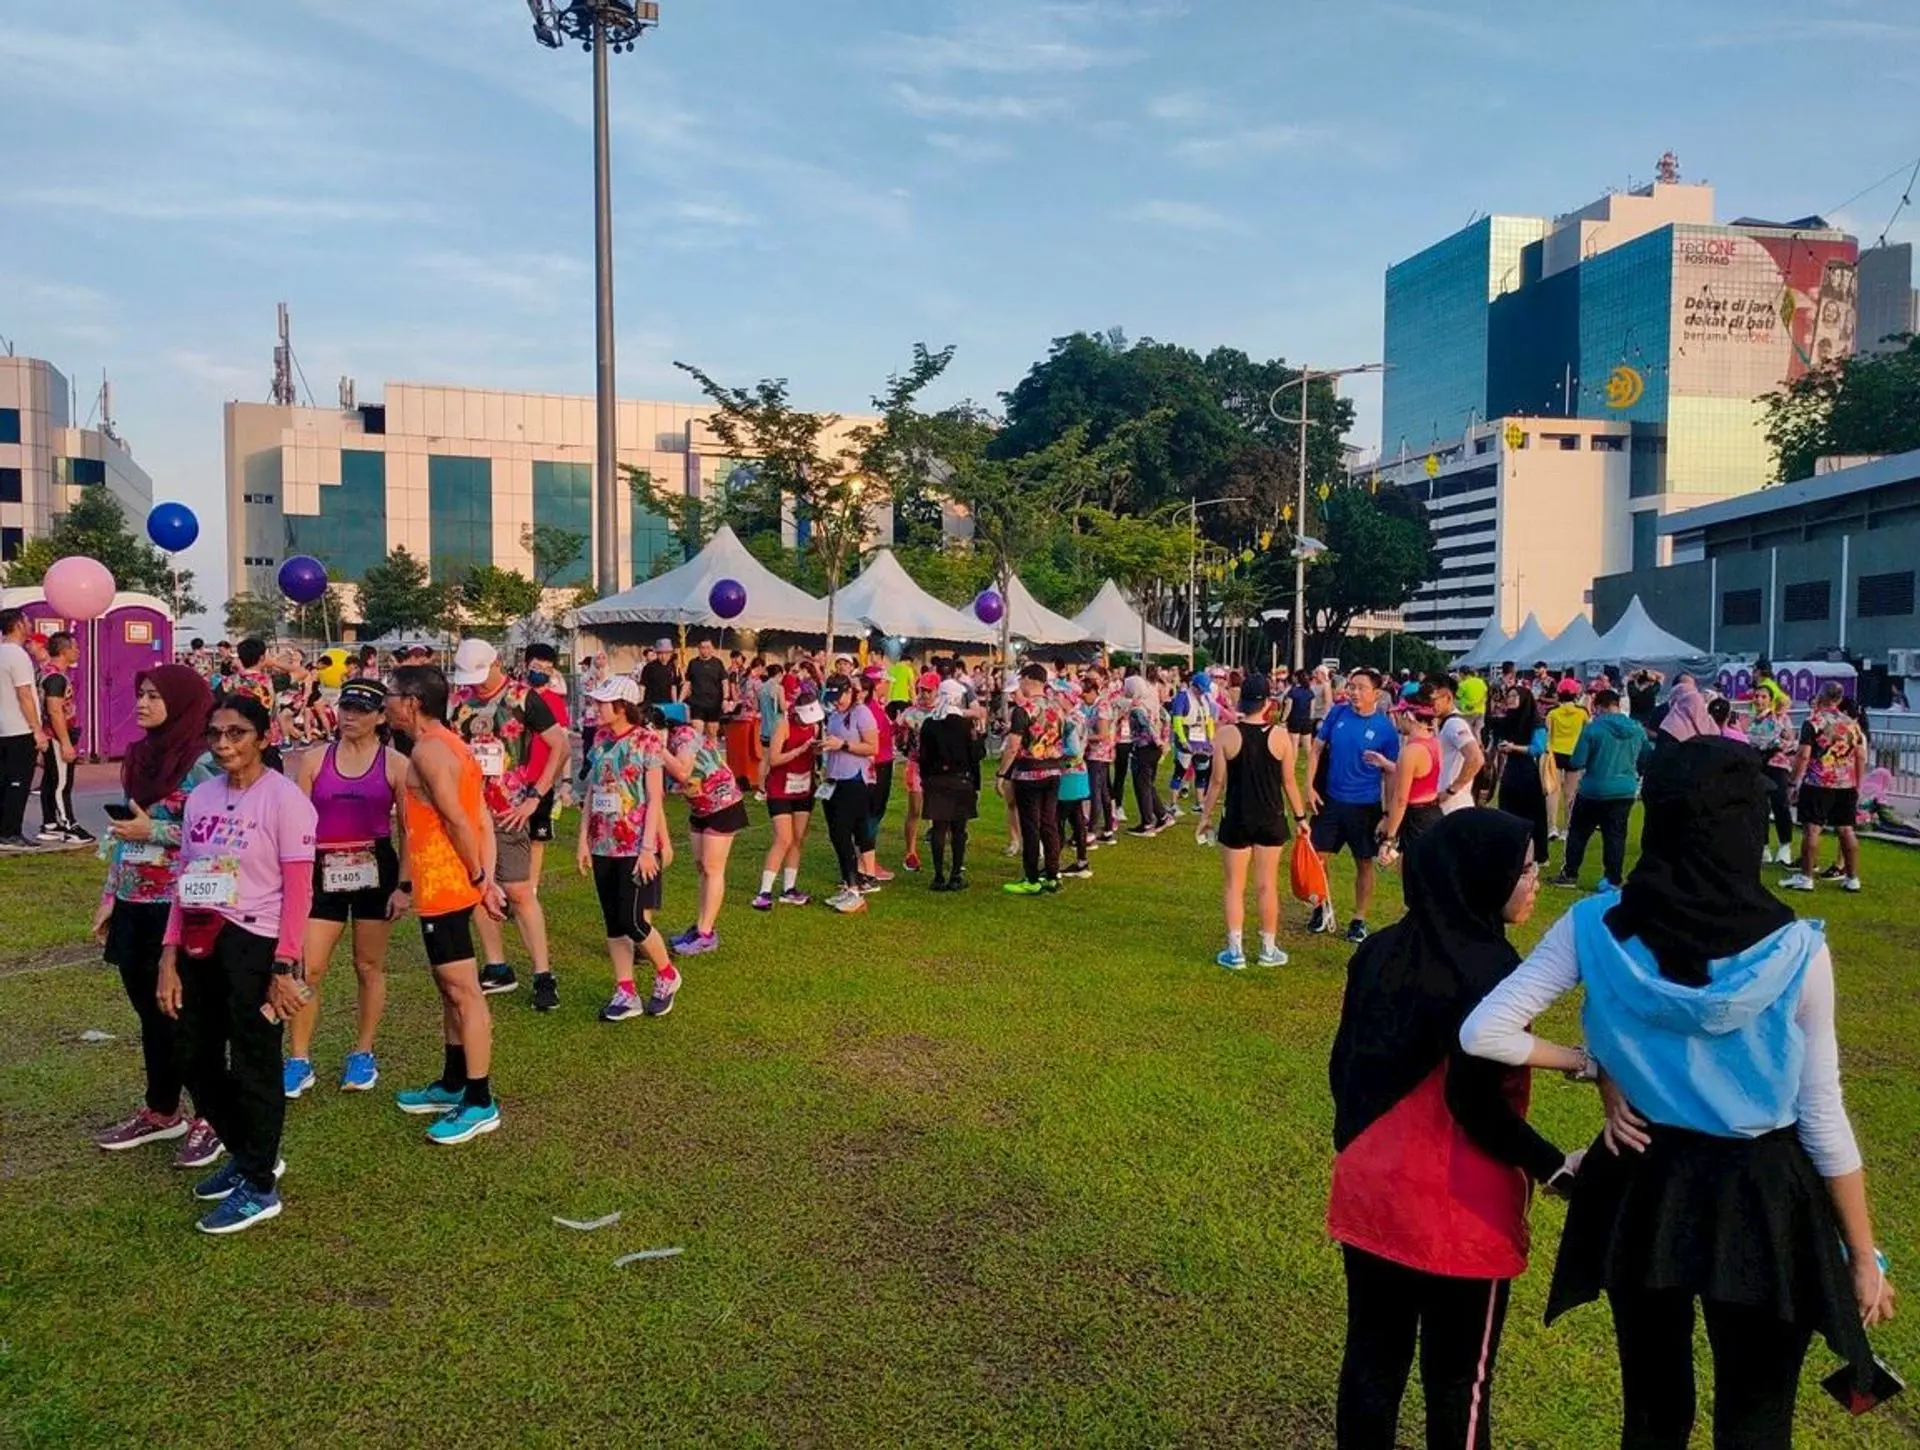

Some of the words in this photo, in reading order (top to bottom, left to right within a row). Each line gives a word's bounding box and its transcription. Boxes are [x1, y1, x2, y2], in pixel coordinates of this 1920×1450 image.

[1680, 239, 1736, 255] redONE
[1684, 254, 1730, 266] POSTPAID
[1731, 299, 1745, 312] di
[1729, 314, 1744, 328] di
[330, 872, 361, 884] E1405
[184, 882, 218, 896] H2507
